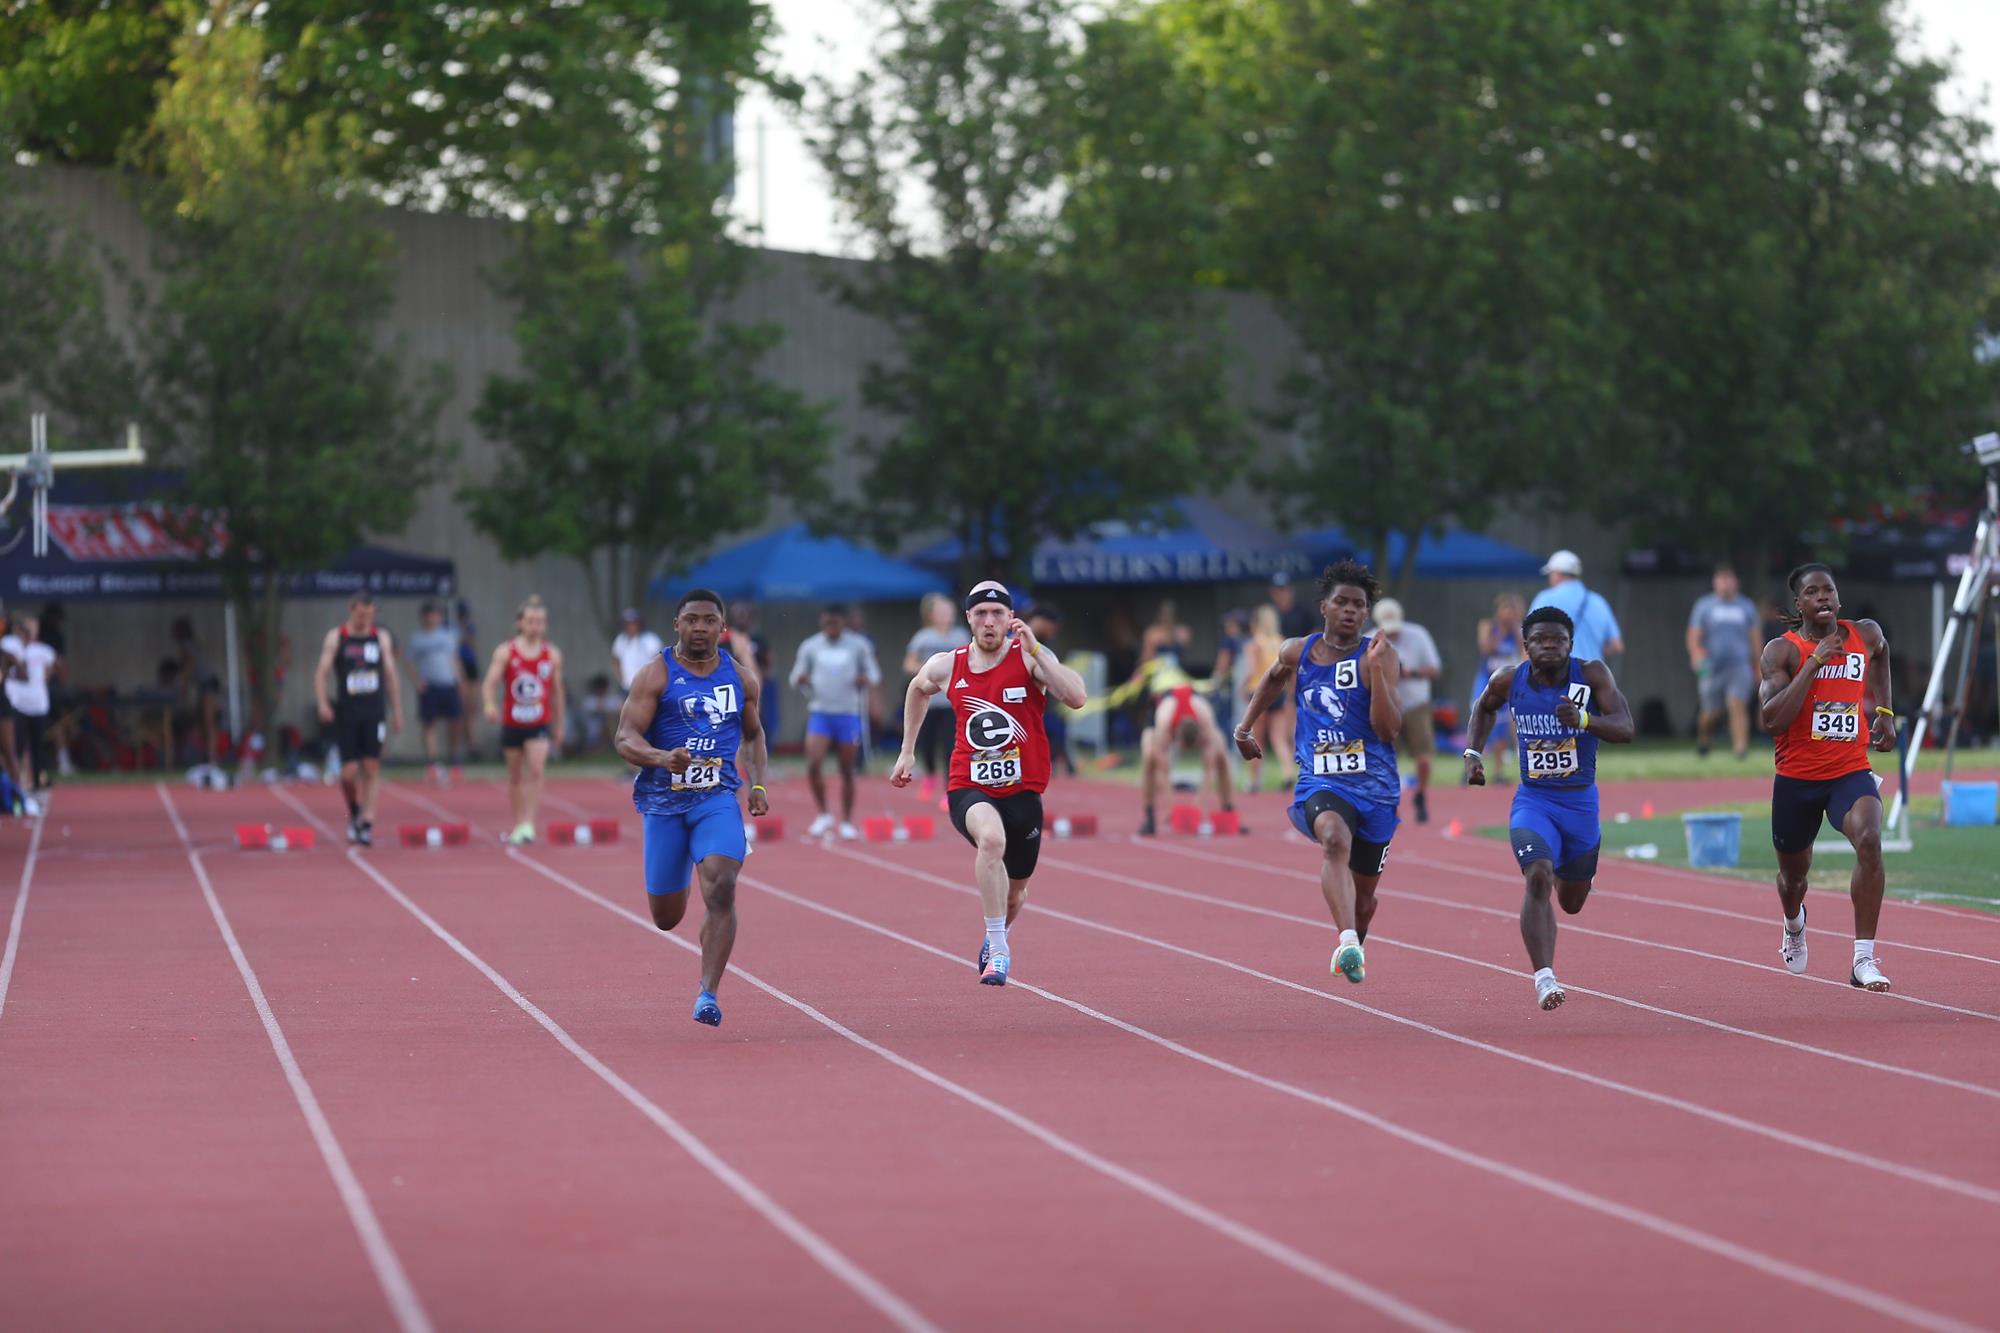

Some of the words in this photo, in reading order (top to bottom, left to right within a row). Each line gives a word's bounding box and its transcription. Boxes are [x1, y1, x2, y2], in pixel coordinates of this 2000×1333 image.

[1337, 662, 1354, 687] 5
[1851, 655, 1861, 679] 3
[718, 687, 729, 711] 7
[1572, 687, 1586, 709] 4
[1818, 714, 1855, 733] 349
[685, 737, 716, 751] EIU
[977, 760, 1015, 780] 268
[1323, 753, 1359, 773] 113
[1533, 751, 1572, 771] 295
[680, 767, 714, 784] 124
